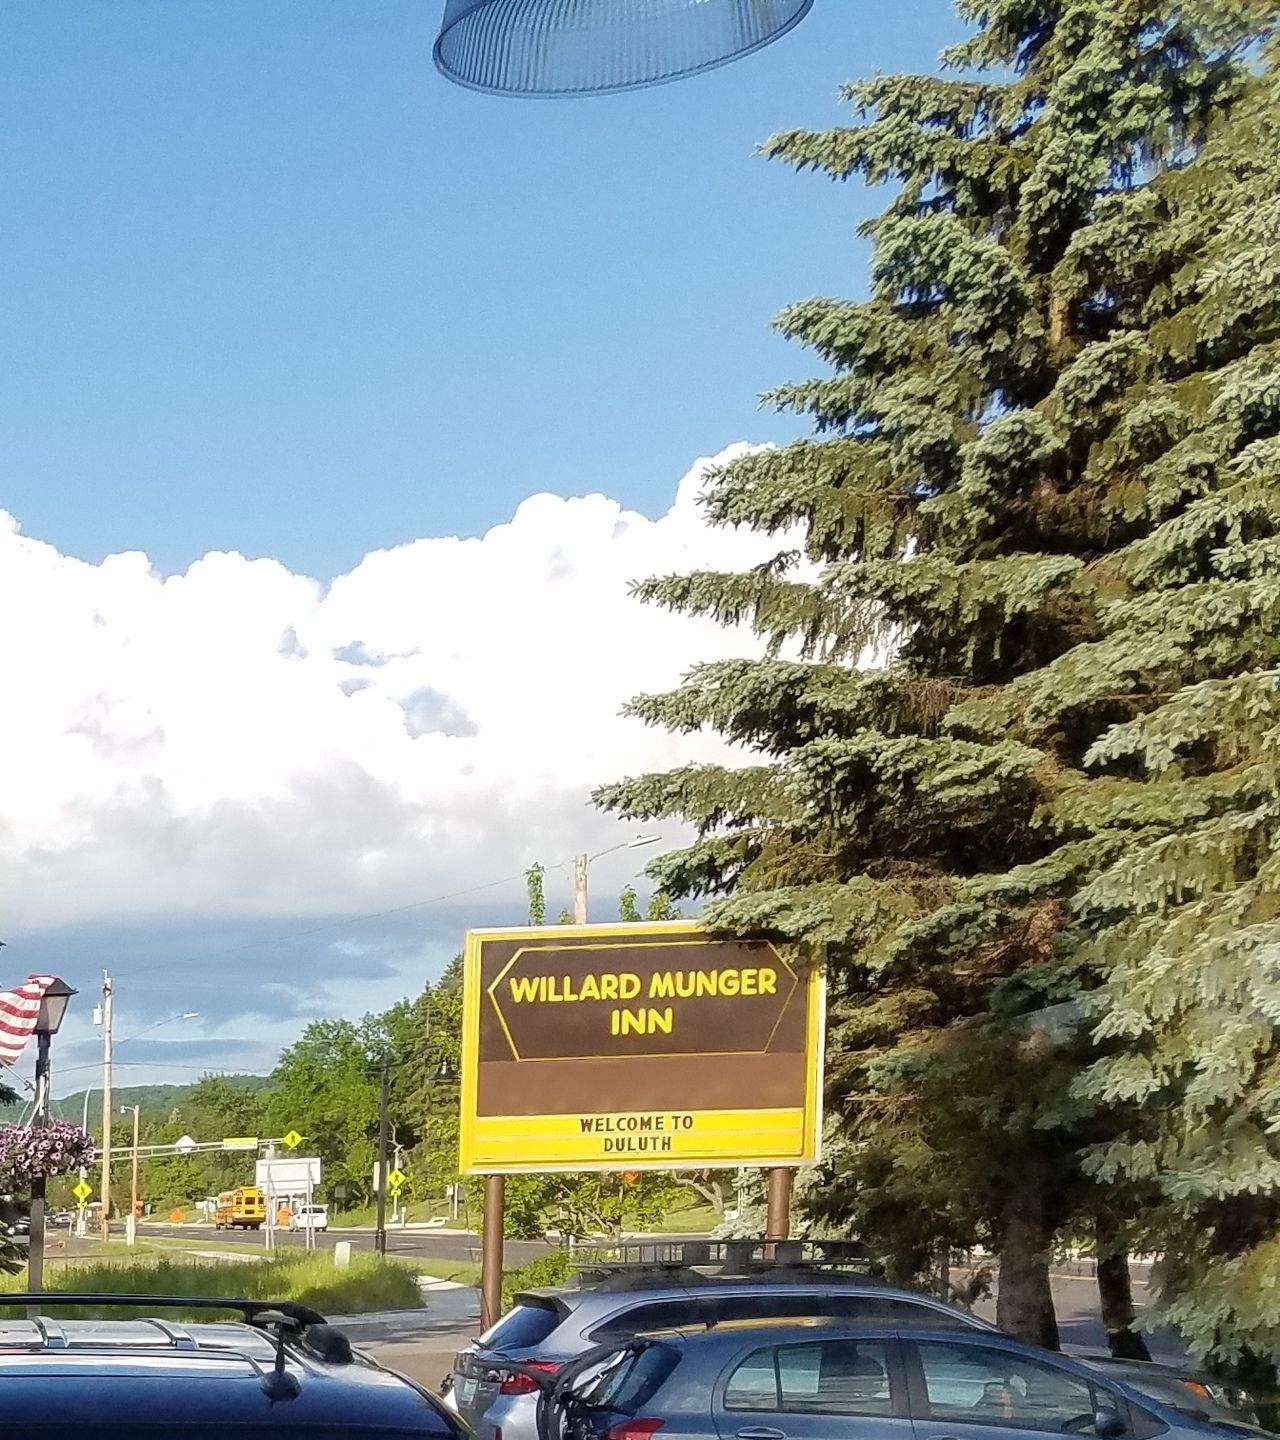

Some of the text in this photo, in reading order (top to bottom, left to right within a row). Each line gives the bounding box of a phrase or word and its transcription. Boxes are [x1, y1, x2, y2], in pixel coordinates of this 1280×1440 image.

[509, 967, 778, 1004] WILLARD MUNGER
[610, 1007, 674, 1036] INN
[580, 1115, 694, 1133] WELCOME TO
[603, 1136, 672, 1152] DULUTH
